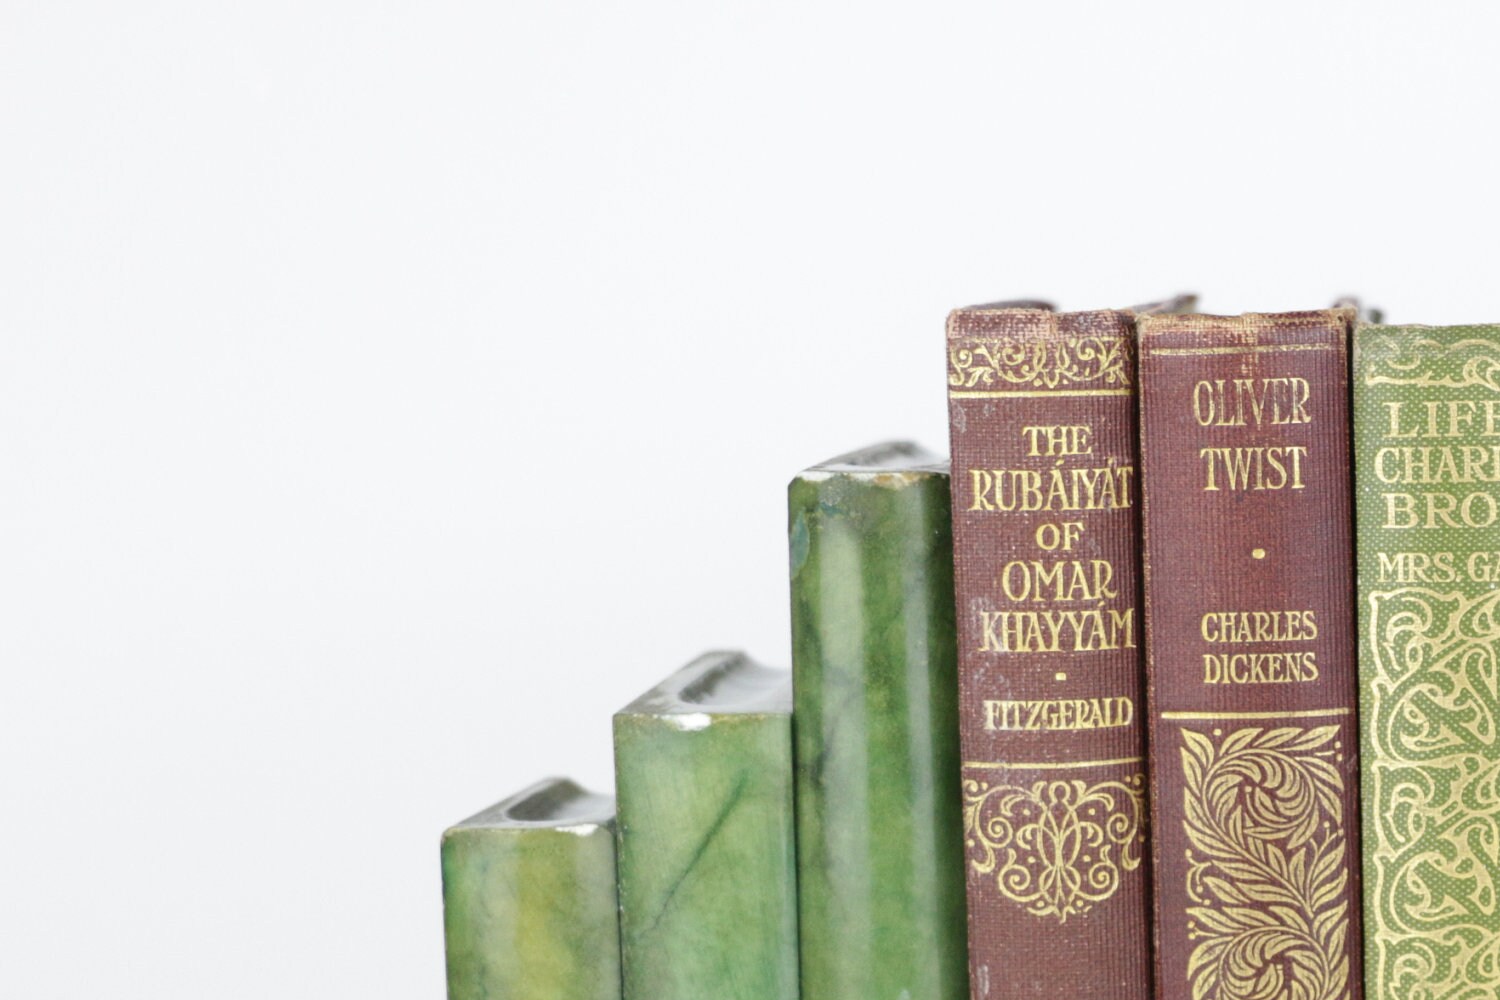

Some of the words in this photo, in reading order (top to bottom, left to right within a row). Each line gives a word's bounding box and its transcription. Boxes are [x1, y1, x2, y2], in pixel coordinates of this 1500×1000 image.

[1193, 377, 1312, 427] OLIVER
[1022, 425, 1094, 457] THE
[967, 458, 1134, 512] RUBÁIYÁT
[1200, 446, 1309, 493] TWIST
[1036, 522, 1086, 552] OF
[1002, 560, 1118, 602] OMAR
[1376, 551, 1462, 584] MRS.
[977, 601, 1137, 653] KHAYYÁM
[1201, 610, 1319, 644] CHARLES
[1203, 651, 1320, 685] DICKENS
[983, 697, 1135, 731] FITZGERALD
